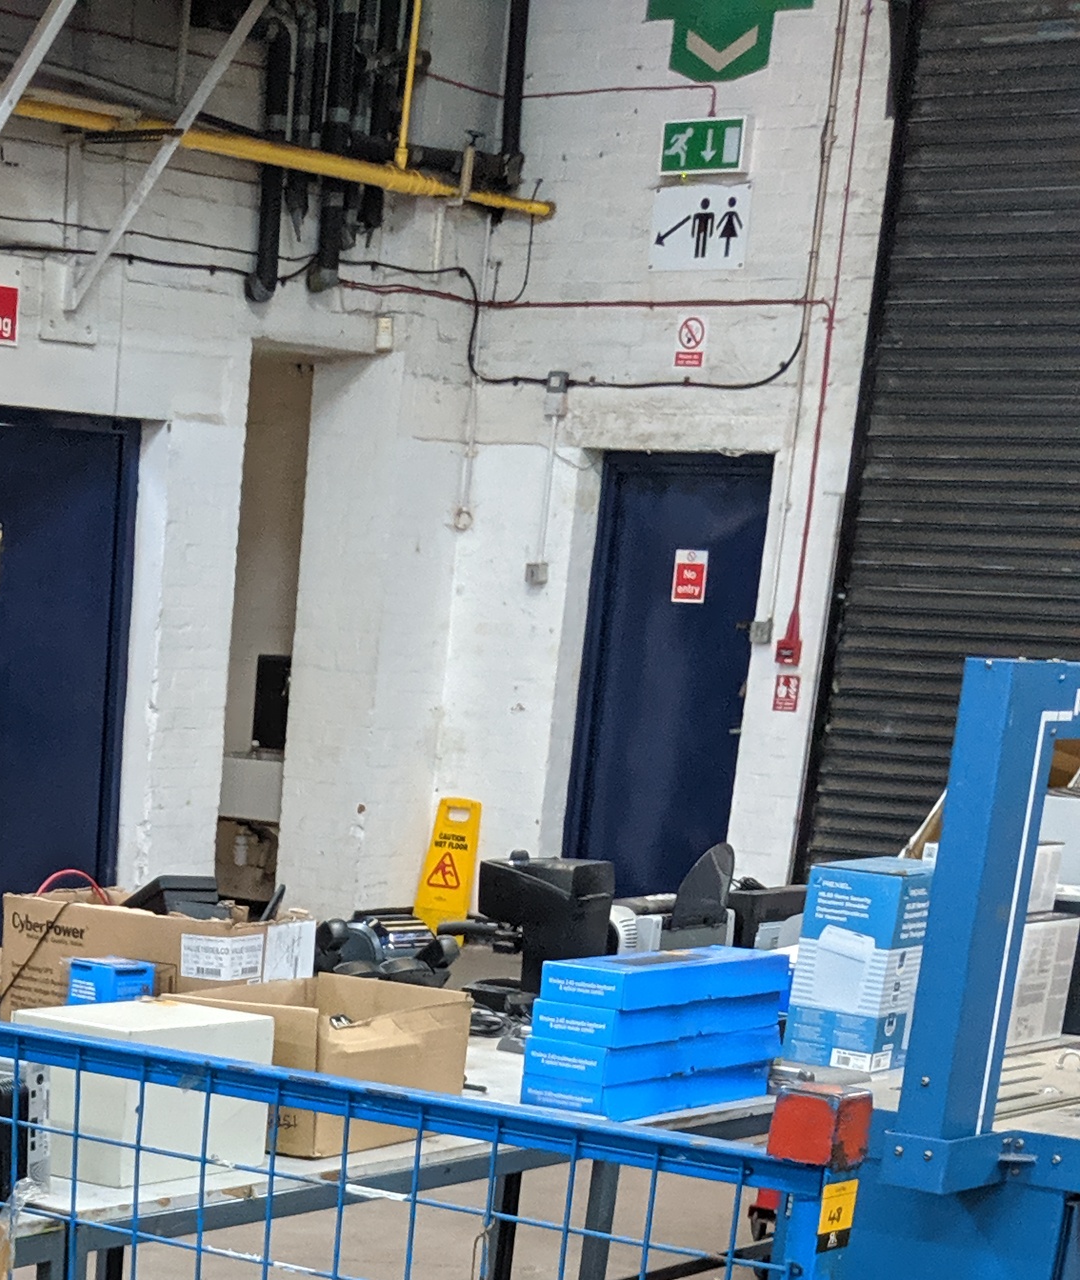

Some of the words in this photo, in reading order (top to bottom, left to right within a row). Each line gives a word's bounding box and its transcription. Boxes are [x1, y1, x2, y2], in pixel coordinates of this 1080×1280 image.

[683, 569, 697, 580] No
[677, 585, 701, 596] entry
[439, 832, 466, 842] CAUTION
[448, 842, 468, 850] FLOOR
[12, 911, 85, 940] CyberPower
[828, 1206, 843, 1225] 48
